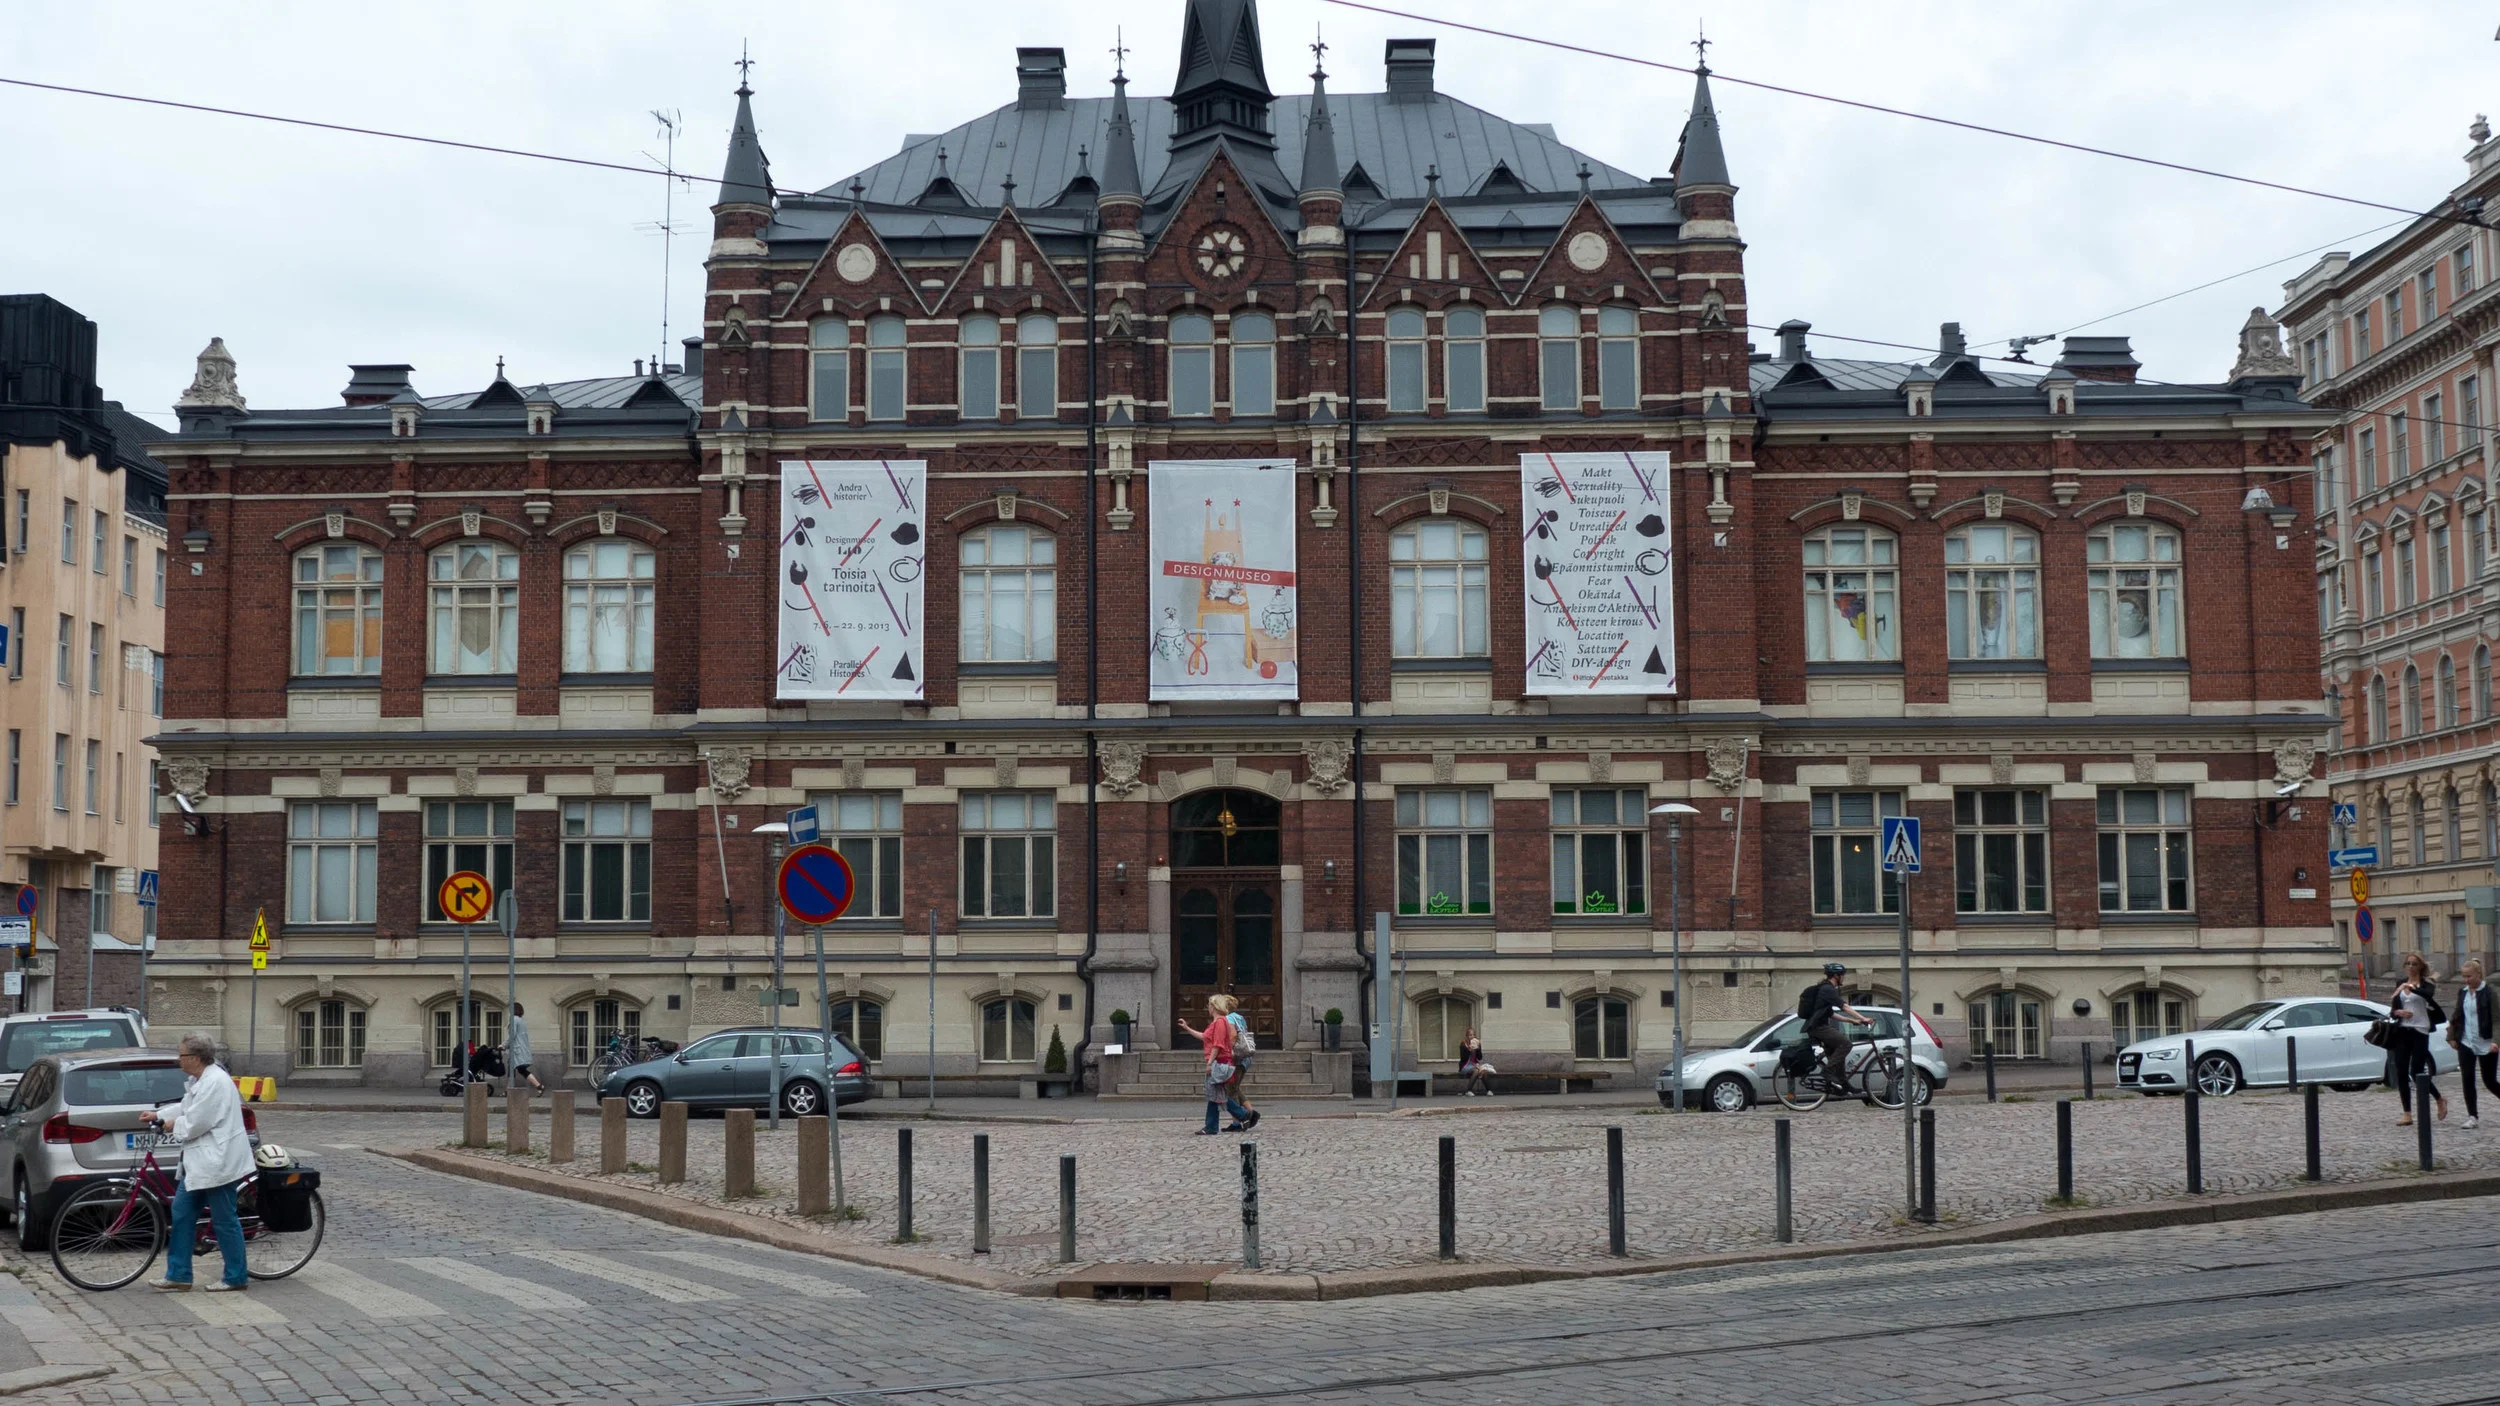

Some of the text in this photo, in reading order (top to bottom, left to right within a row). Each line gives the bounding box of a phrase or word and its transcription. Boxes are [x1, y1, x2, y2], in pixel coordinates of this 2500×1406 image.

[1582, 468, 1612, 478] Makt
[838, 483, 862, 492] Andra
[1572, 481, 1623, 492] Sexuality
[834, 492, 867, 500] historier
[1570, 494, 1624, 506] Sukupuoli
[1578, 508, 1617, 518] Toiseus
[832, 568, 866, 580] Toisia
[1174, 564, 1271, 582] DESIGNMUSEO
[1588, 576, 1612, 586] Fear
[823, 581, 876, 592] tarinoita
[1578, 590, 1621, 600] Okända
[1610, 617, 1643, 626] kirous
[868, 623, 890, 632] 2013
[1578, 630, 1624, 640] Location
[834, 660, 862, 668] Parallel
[2354, 876, 2366, 895] 30
